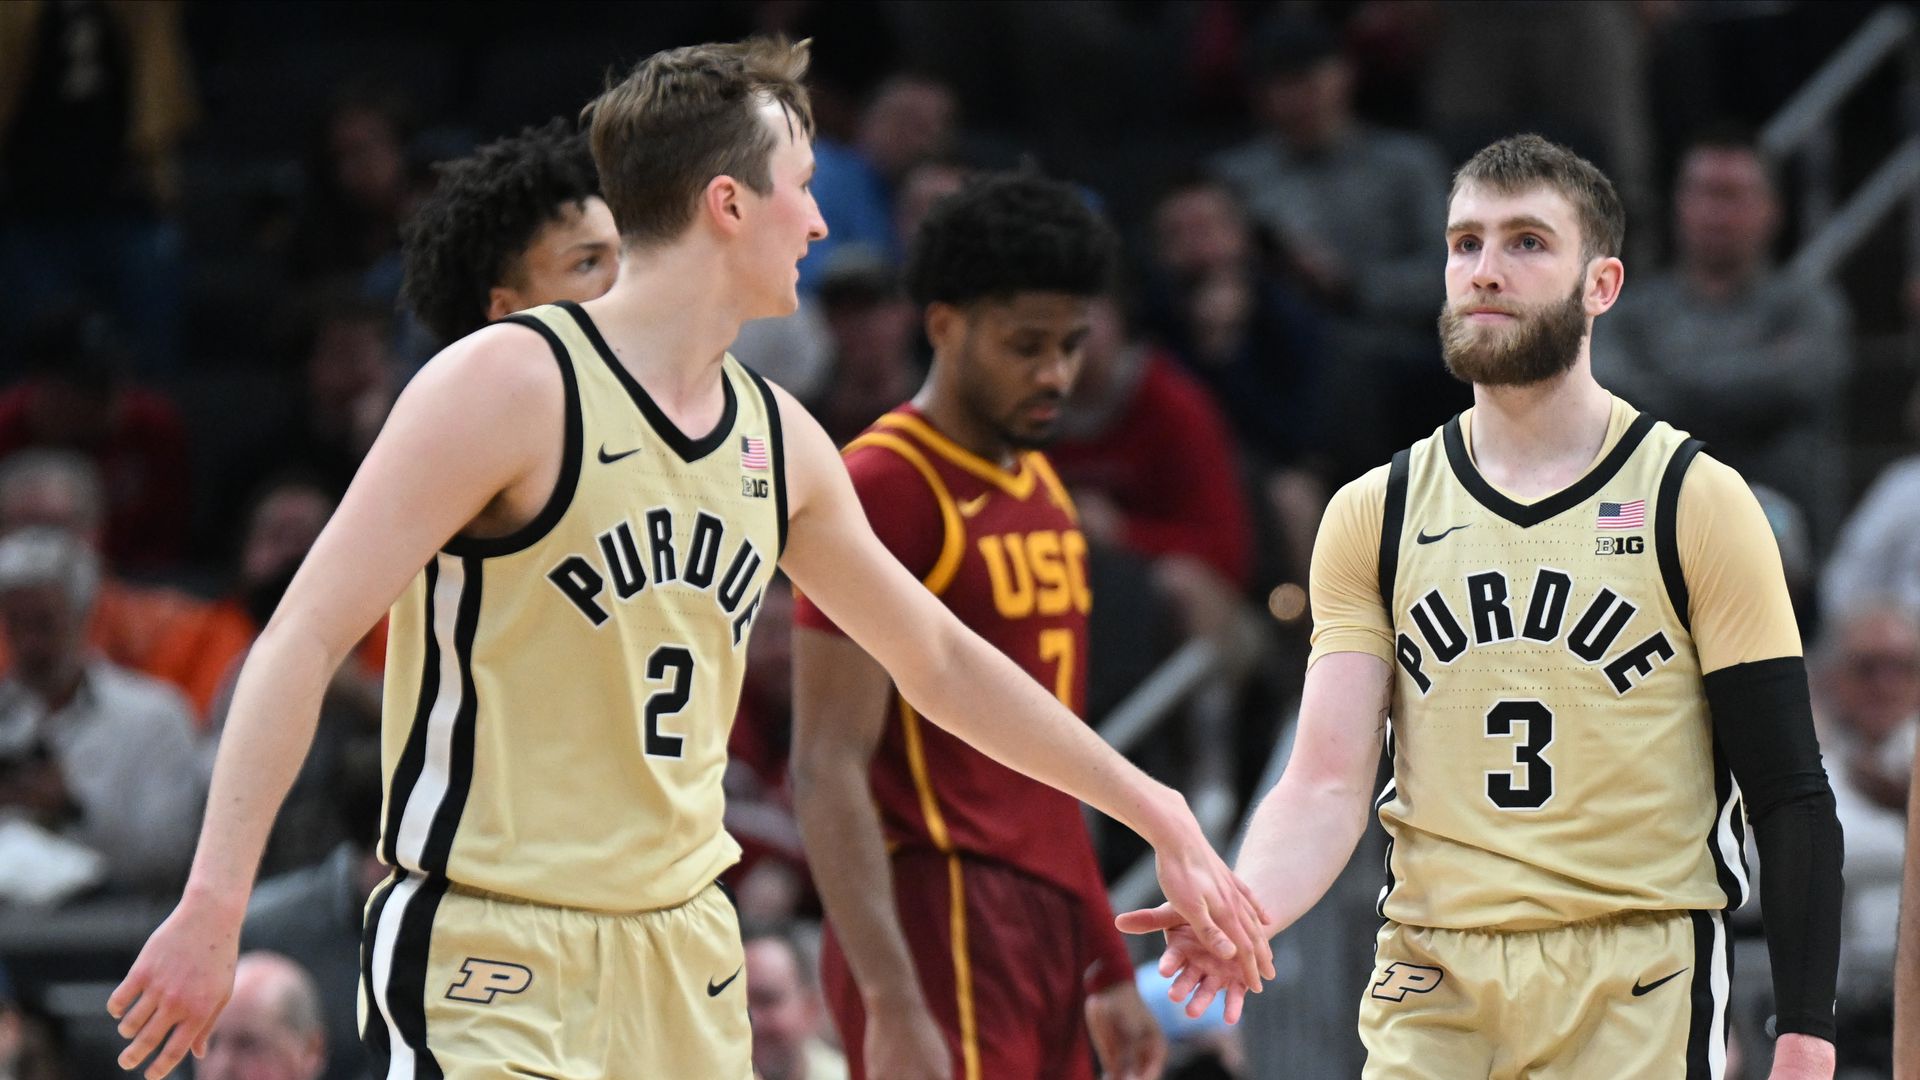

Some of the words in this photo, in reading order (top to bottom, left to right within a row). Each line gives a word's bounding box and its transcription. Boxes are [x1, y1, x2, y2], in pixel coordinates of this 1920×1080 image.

[1039, 627, 1075, 709] 7
[1397, 565, 1678, 697] PURDUE
[644, 646, 694, 758] 2
[1484, 698, 1555, 812] 3
[445, 957, 533, 1004] P
[1371, 961, 1444, 1003] P
